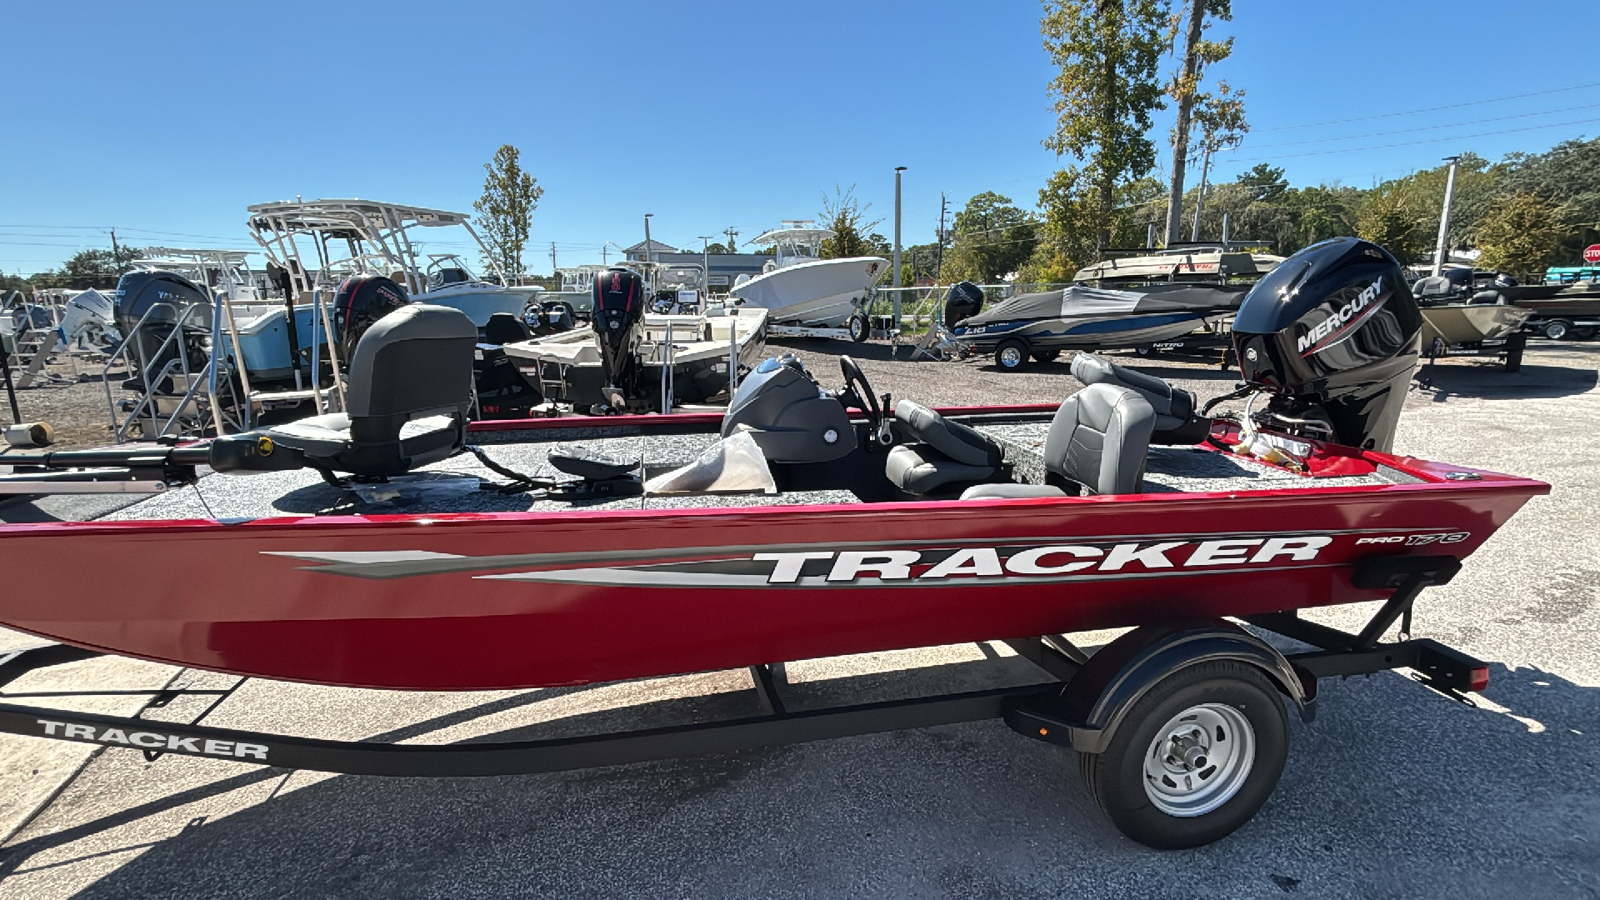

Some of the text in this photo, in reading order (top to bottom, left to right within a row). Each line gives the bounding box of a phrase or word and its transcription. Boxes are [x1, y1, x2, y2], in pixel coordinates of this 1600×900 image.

[1297, 275, 1382, 353] MERCURY
[752, 536, 1332, 584] TRACKER
[1355, 536, 1405, 545] PRO
[37, 719, 270, 760] TRACKER
